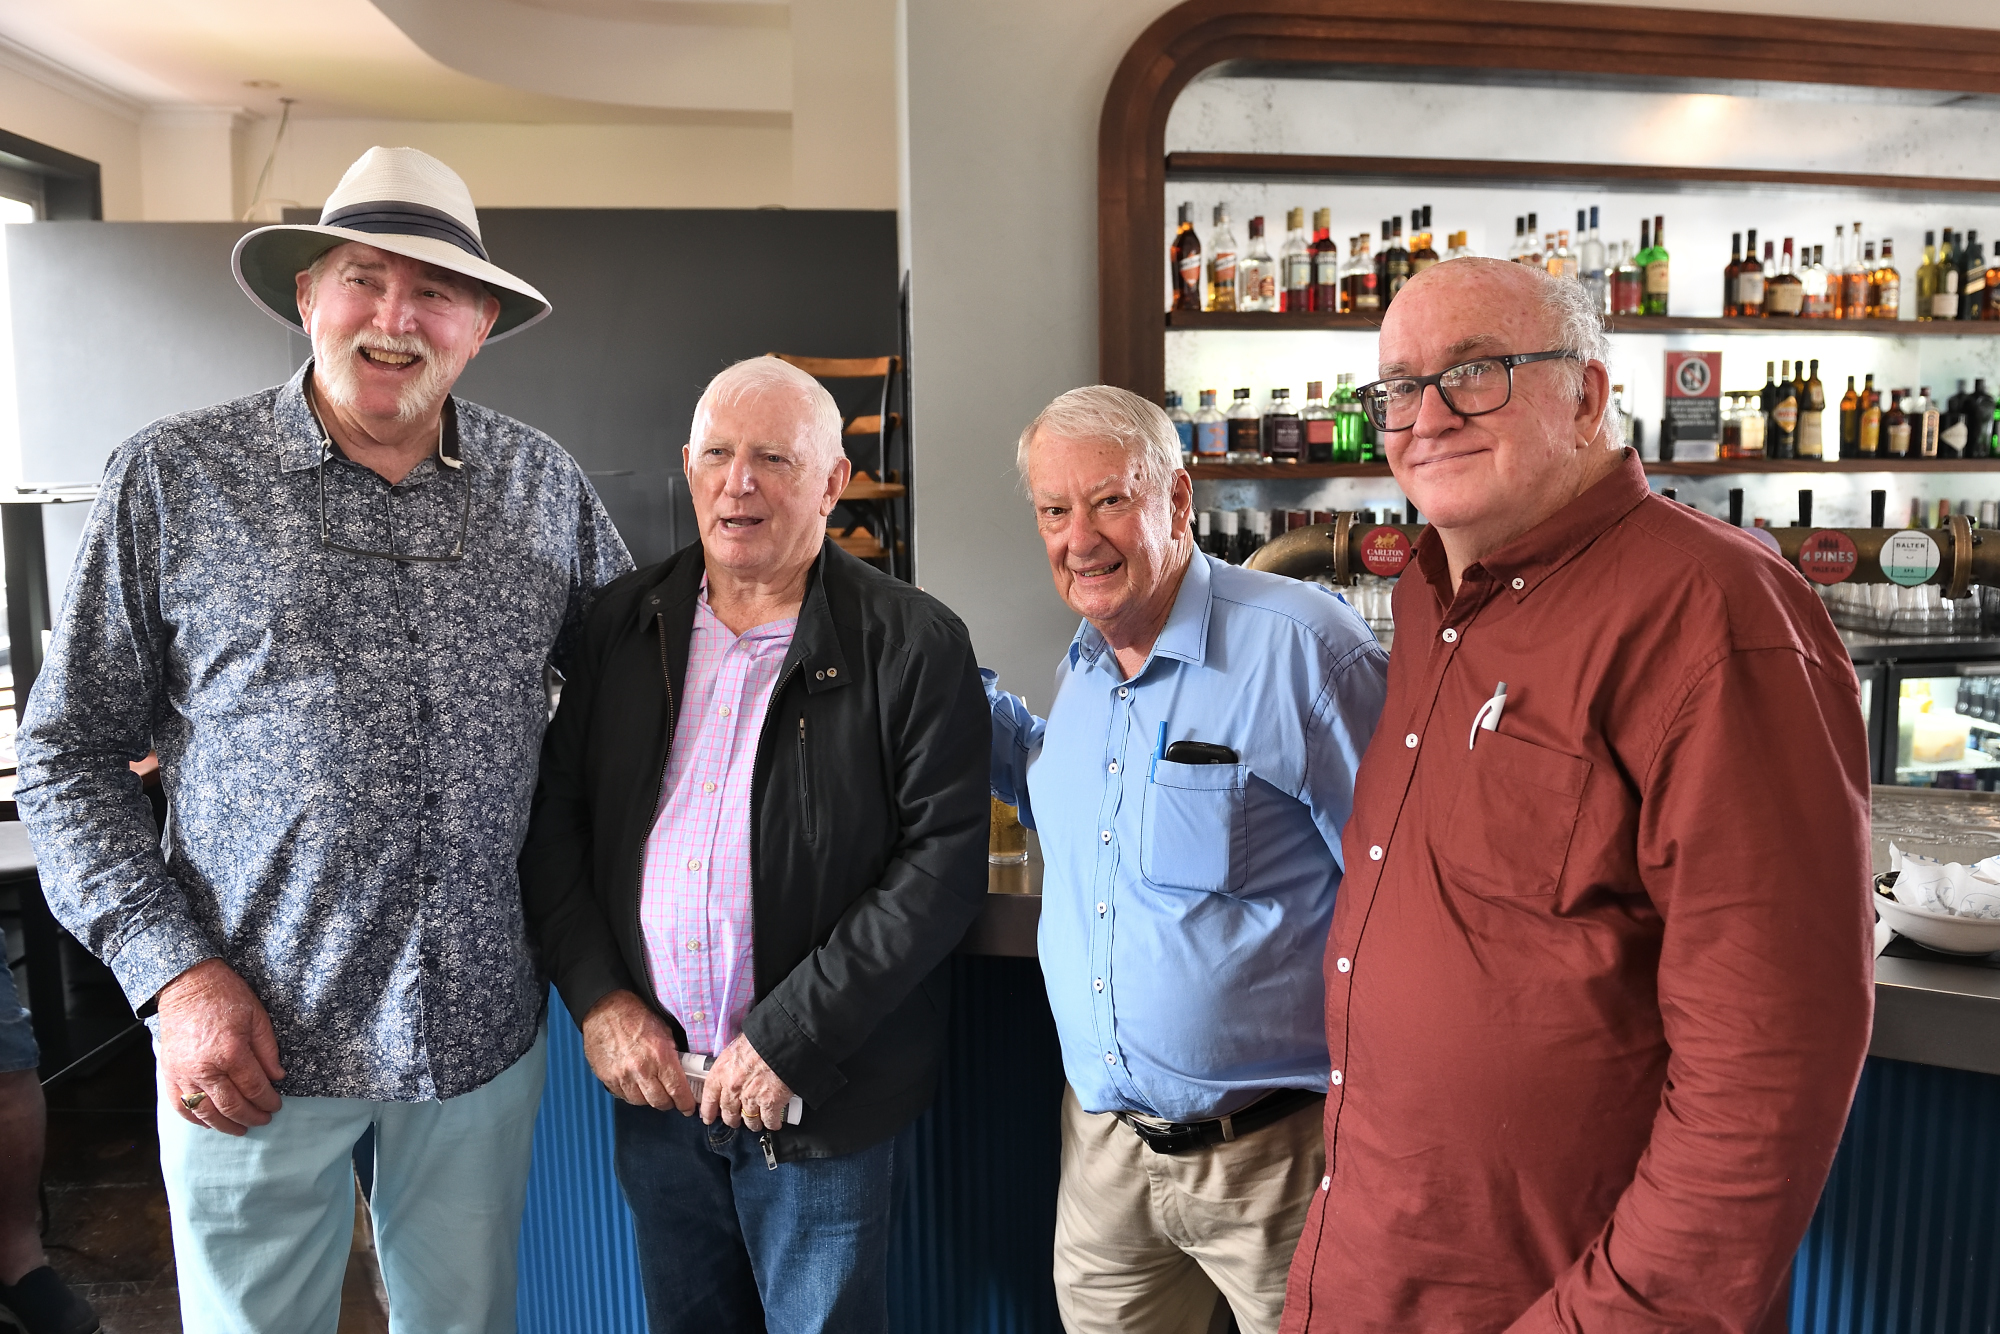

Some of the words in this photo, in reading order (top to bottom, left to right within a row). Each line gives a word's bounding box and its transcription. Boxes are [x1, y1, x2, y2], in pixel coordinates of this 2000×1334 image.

[1802, 551, 1811, 562] 4
[1814, 551, 1854, 563] PINES
[1812, 565, 1829, 573] PALE
[1830, 566, 1845, 574] ALE
